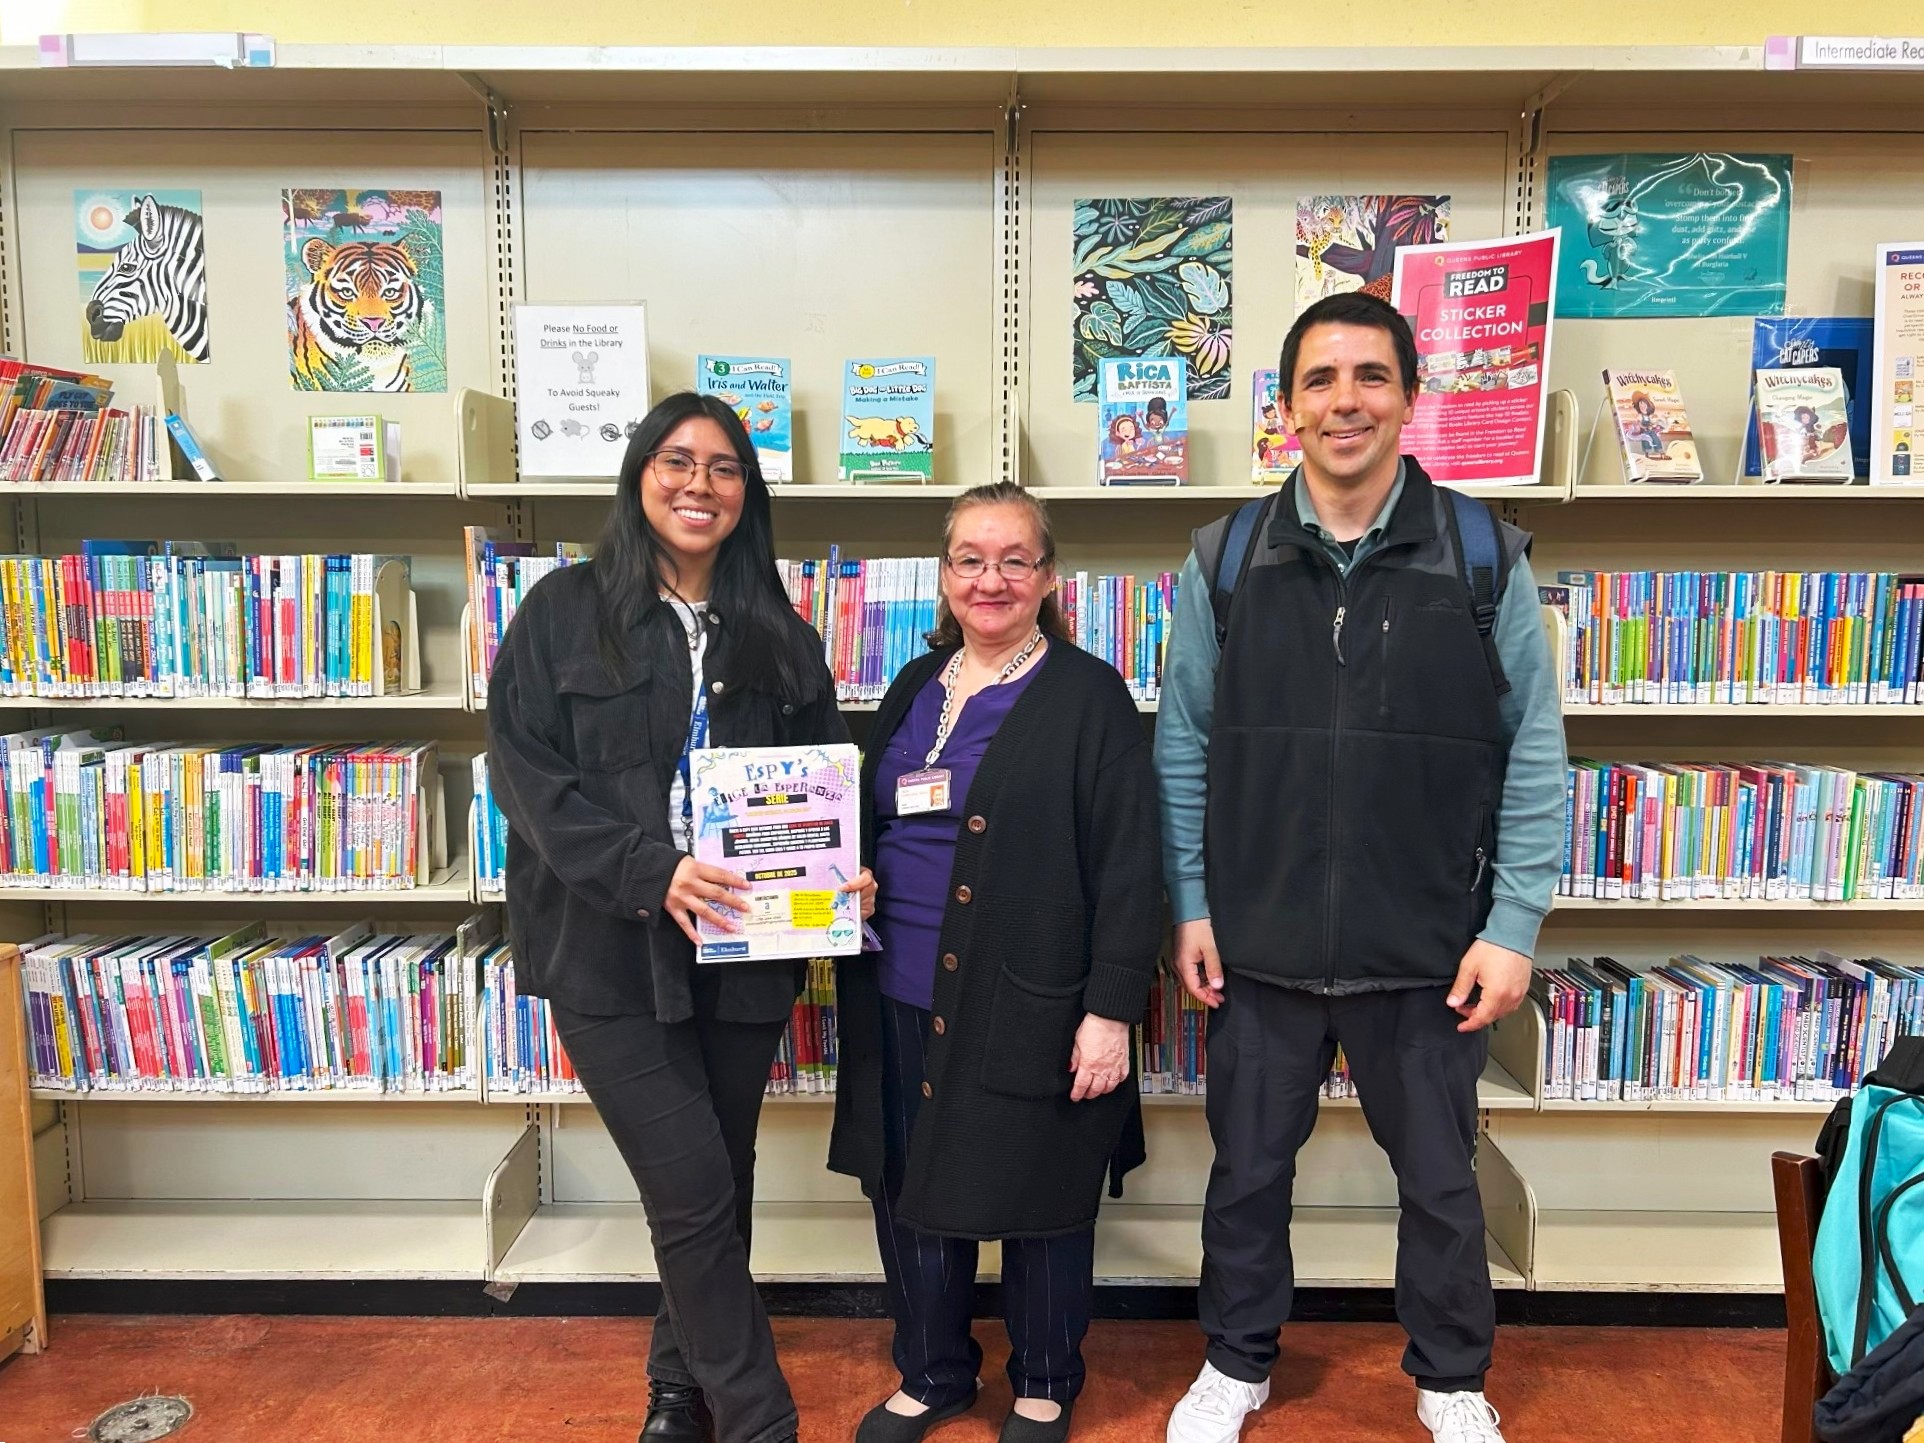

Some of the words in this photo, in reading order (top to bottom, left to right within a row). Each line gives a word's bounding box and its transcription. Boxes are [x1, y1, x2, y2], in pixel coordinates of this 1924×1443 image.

[1816, 40, 1896, 59] Intermediate
[1723, 214, 1738, 222] into
[1496, 250, 1522, 258] LIBRARY
[1450, 268, 1492, 280] FREEDOM
[1492, 266, 1504, 275] TO
[1449, 276, 1504, 297] READ
[1440, 304, 1506, 322] STICKER
[544, 324, 570, 332] Please
[572, 324, 585, 334] No
[586, 324, 608, 334] Food
[609, 326, 618, 334] or
[1420, 320, 1523, 341] COLLECTION
[540, 339, 567, 348] Drinks
[568, 339, 577, 348] in
[578, 339, 592, 348] the
[594, 339, 623, 348] Library
[1780, 348, 1792, 364] CAT
[1792, 347, 1820, 366] CAPERS
[718, 364, 726, 373] 3
[737, 364, 753, 372] Can
[754, 364, 777, 372] Read!
[881, 366, 898, 374] Can
[898, 364, 920, 372] Read!
[1116, 362, 1172, 382] RICA
[708, 377, 728, 390] Iris
[730, 380, 746, 390] and
[748, 379, 789, 392] Walter
[1118, 380, 1172, 391] BAPTISTA
[1616, 372, 1672, 389] Witchycakes
[1764, 374, 1833, 388] Witchycakes
[58, 391, 71, 400] FLY
[74, 391, 88, 400] GUY
[548, 389, 558, 397] To
[560, 389, 584, 397] Avoid
[586, 389, 620, 398] Squeaky
[850, 386, 863, 396] BIG
[864, 386, 878, 394] DOG
[886, 385, 911, 394] LITTLE
[912, 384, 926, 394] DOG
[70, 400, 80, 409] TO
[856, 396, 881, 404] Making
[568, 403, 600, 412] Guests!
[766, 793, 790, 804] SERIE
[754, 870, 776, 880] OCTUBRE
[777, 870, 783, 878] DE
